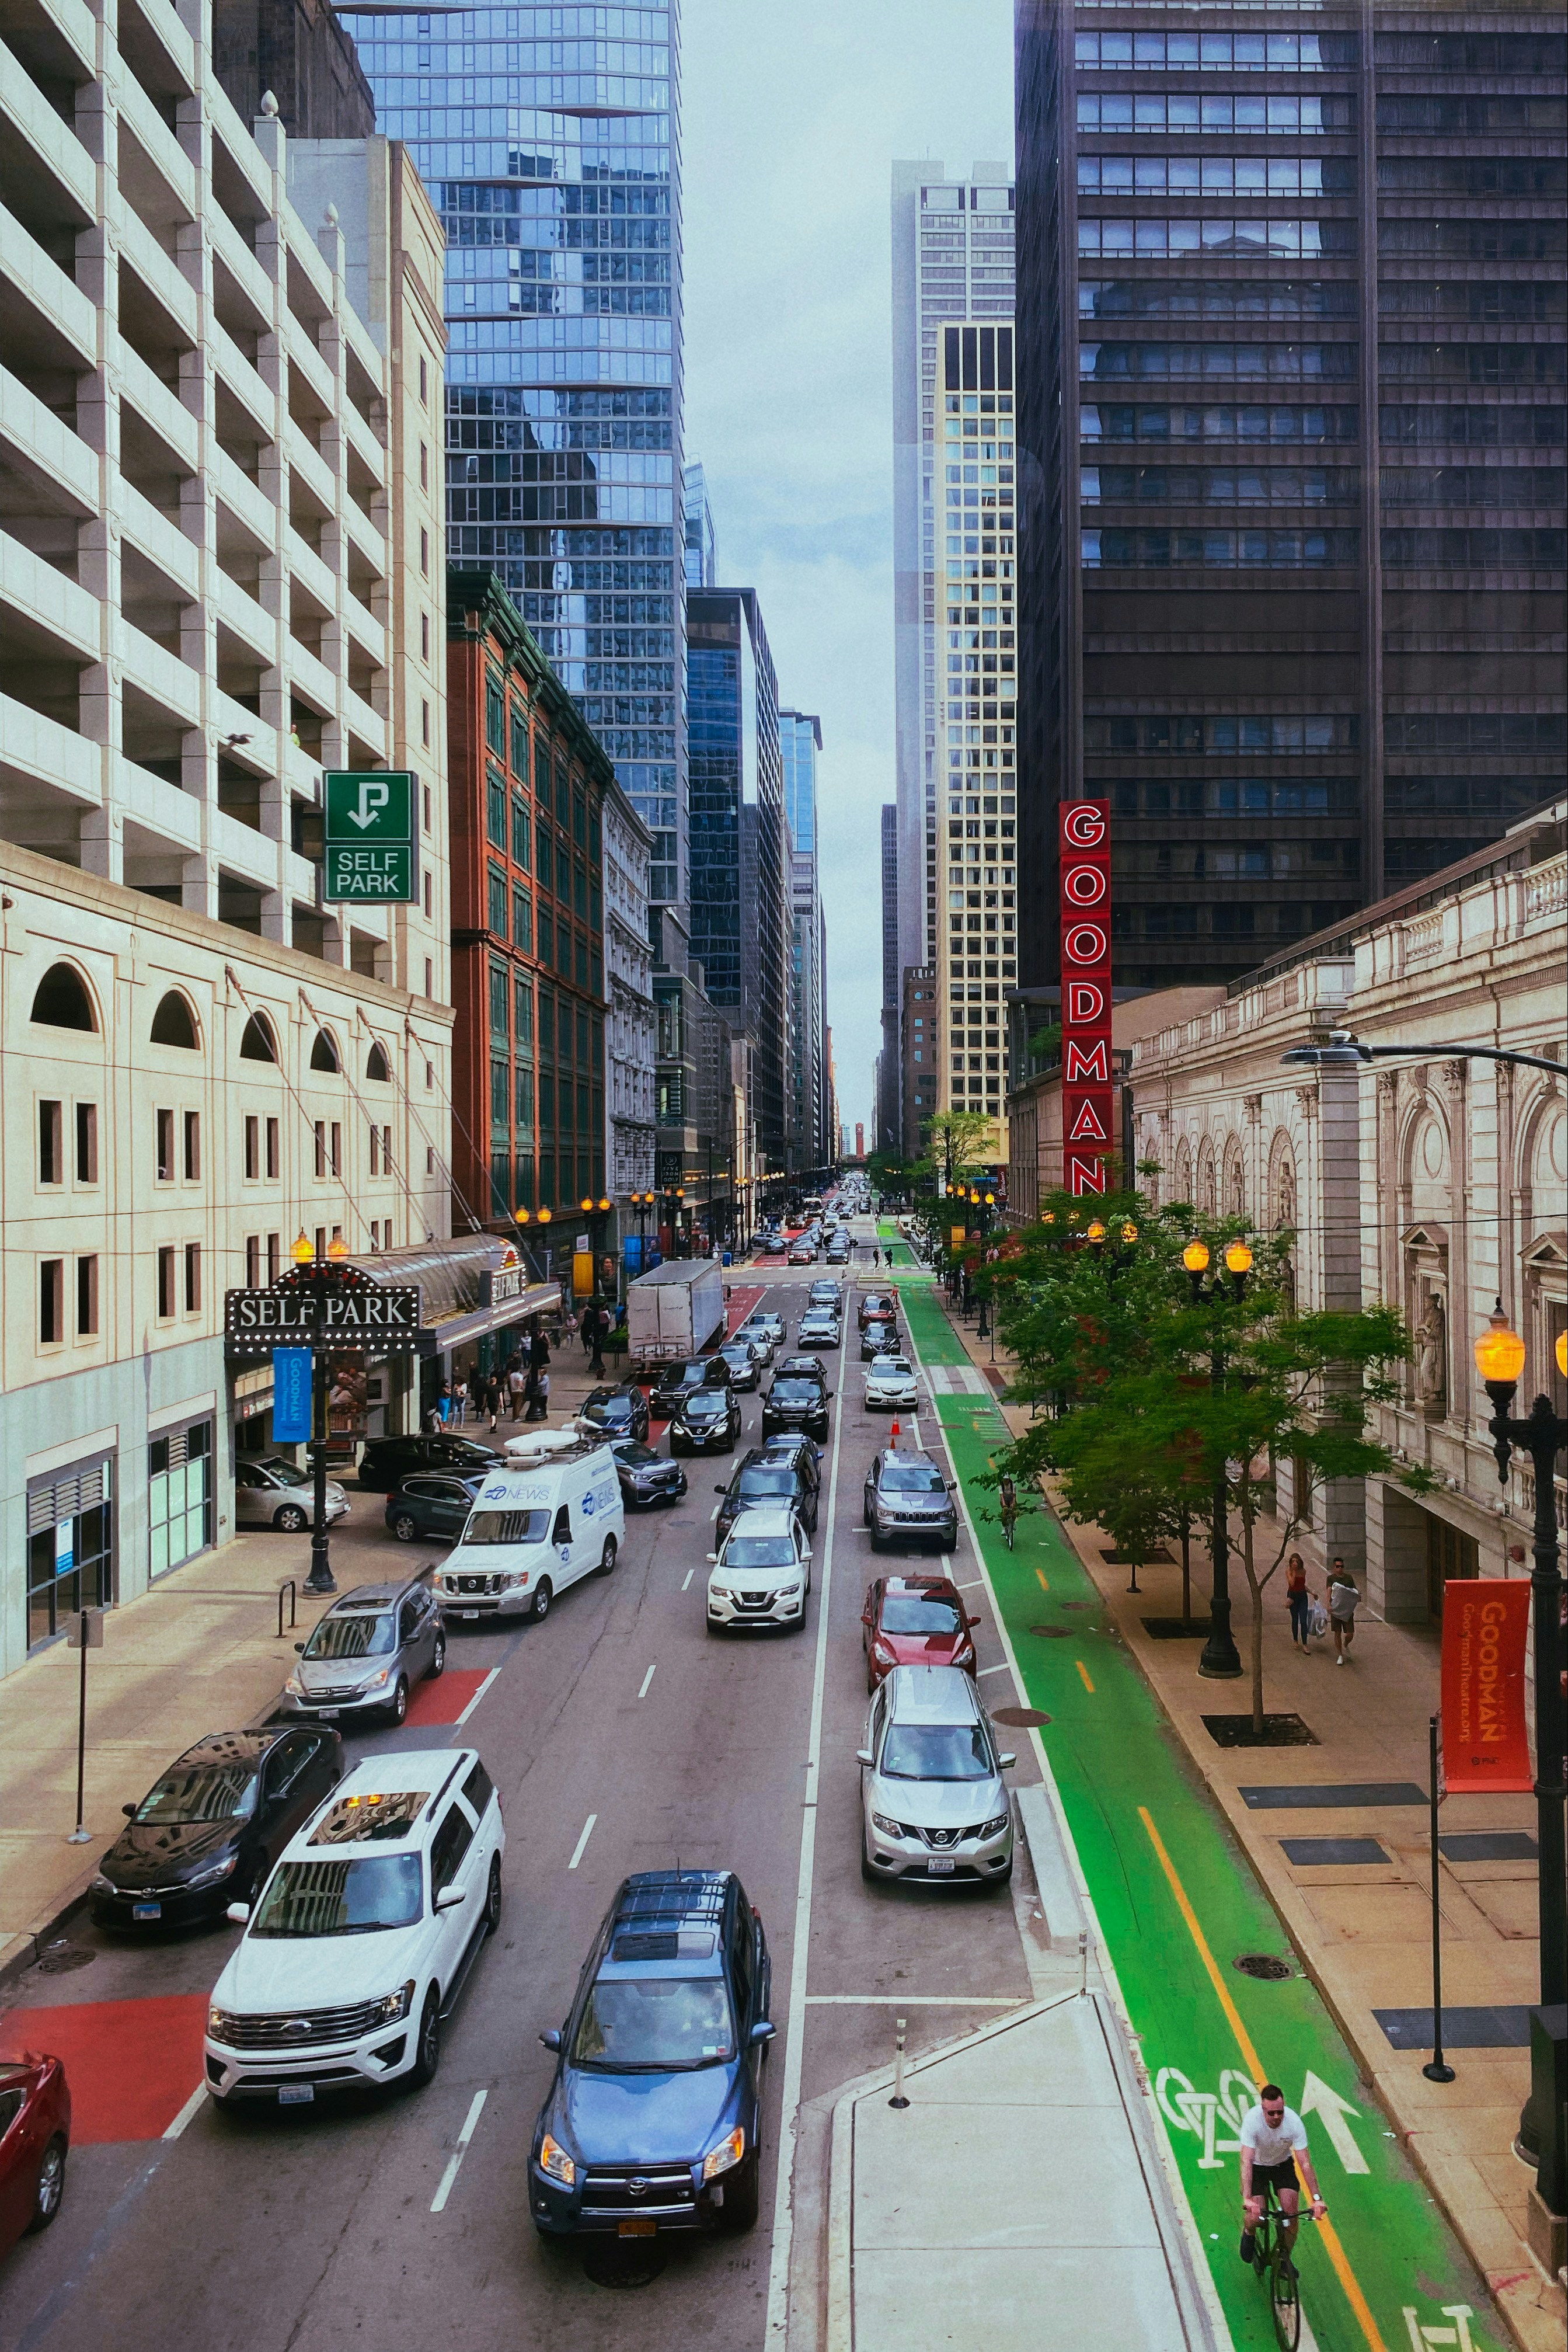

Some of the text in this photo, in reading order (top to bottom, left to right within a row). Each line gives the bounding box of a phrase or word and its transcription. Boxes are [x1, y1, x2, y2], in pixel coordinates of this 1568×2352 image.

[337, 852, 399, 871] SELF
[336, 874, 399, 892] PARK
[1064, 805, 1107, 1196] GOODMAN
[240, 1296, 408, 1327] SELF PARK
[291, 1358, 302, 1421] GOODMAN
[506, 1489, 549, 1501] NEWS
[1480, 1602, 1507, 1741] GOODMAN
